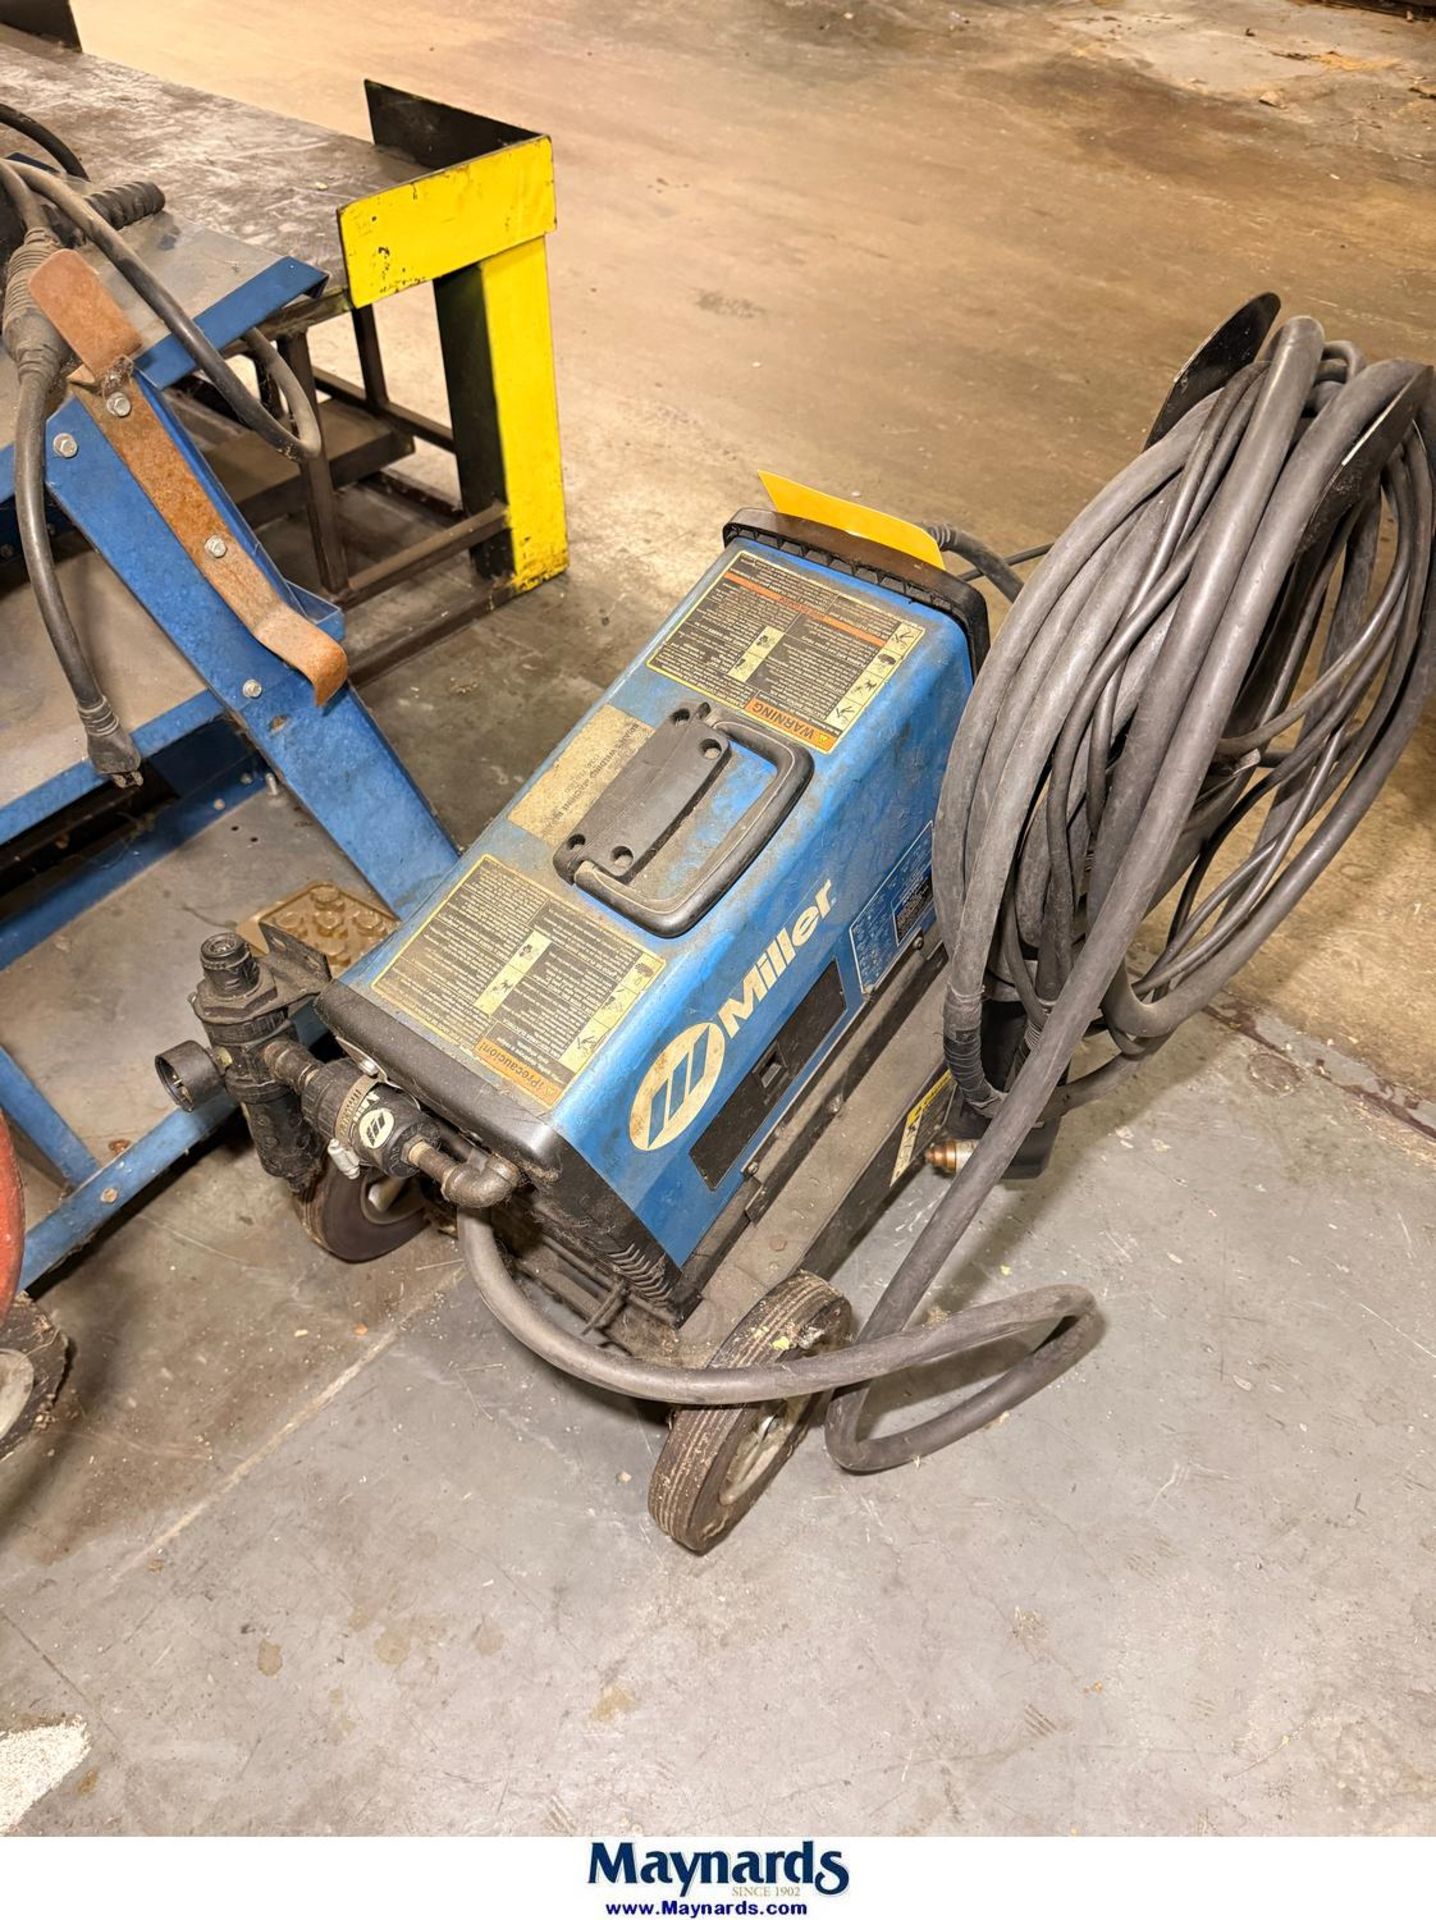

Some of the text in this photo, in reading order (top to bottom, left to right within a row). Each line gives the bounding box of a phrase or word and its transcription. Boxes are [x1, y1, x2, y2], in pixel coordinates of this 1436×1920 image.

[751, 702, 816, 739] WARNING
[588, 748, 616, 779] WELDING
[718, 879, 832, 1038] Miller
